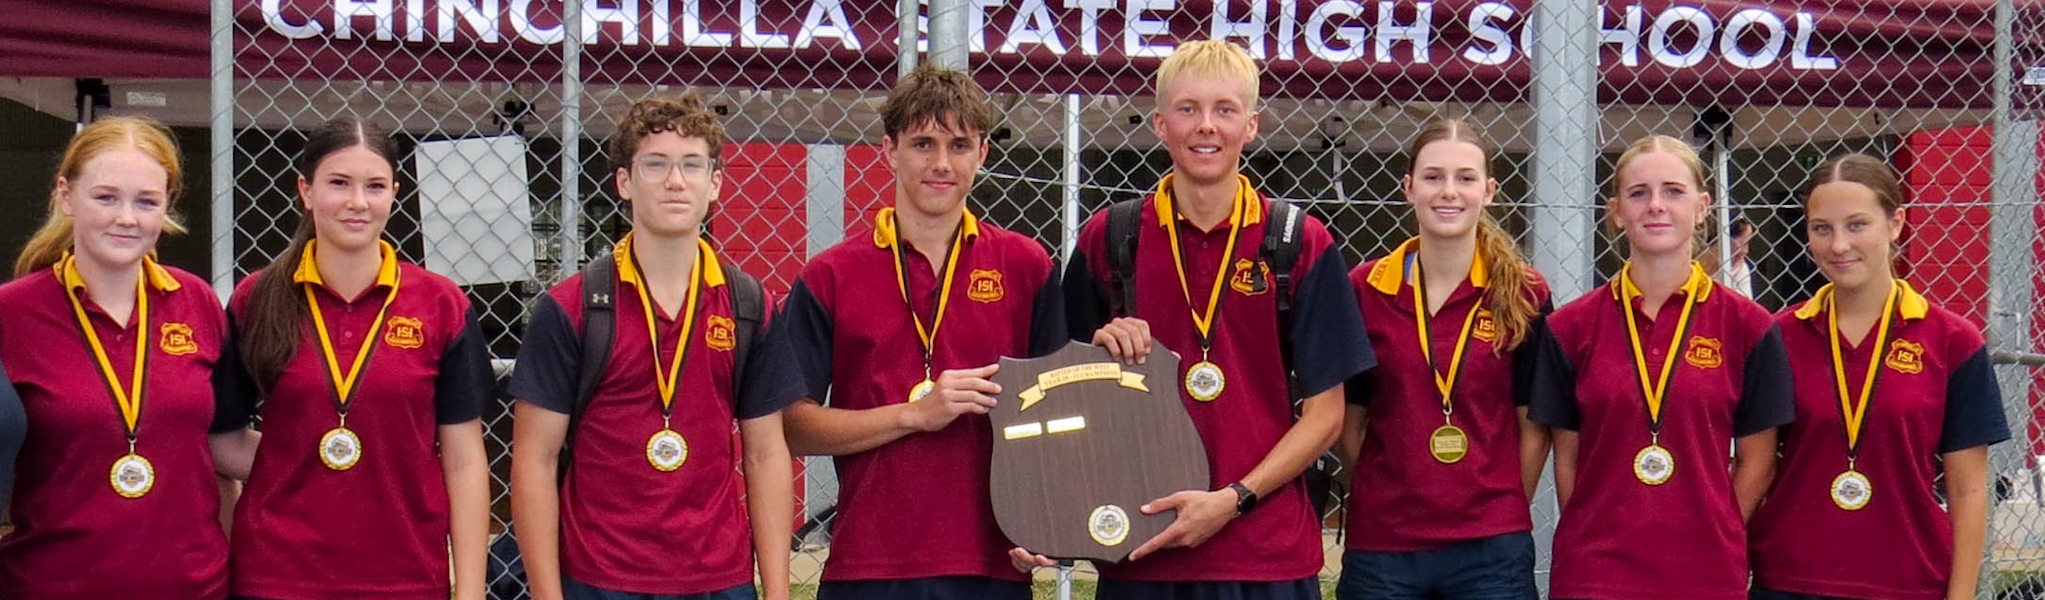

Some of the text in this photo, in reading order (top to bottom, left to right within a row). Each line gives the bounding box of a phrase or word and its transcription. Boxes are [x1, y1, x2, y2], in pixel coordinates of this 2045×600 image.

[261, 0, 862, 49] CHINCHILLA
[1210, 0, 1434, 63] HIGH
[1463, 2, 1838, 69] SHOOL
